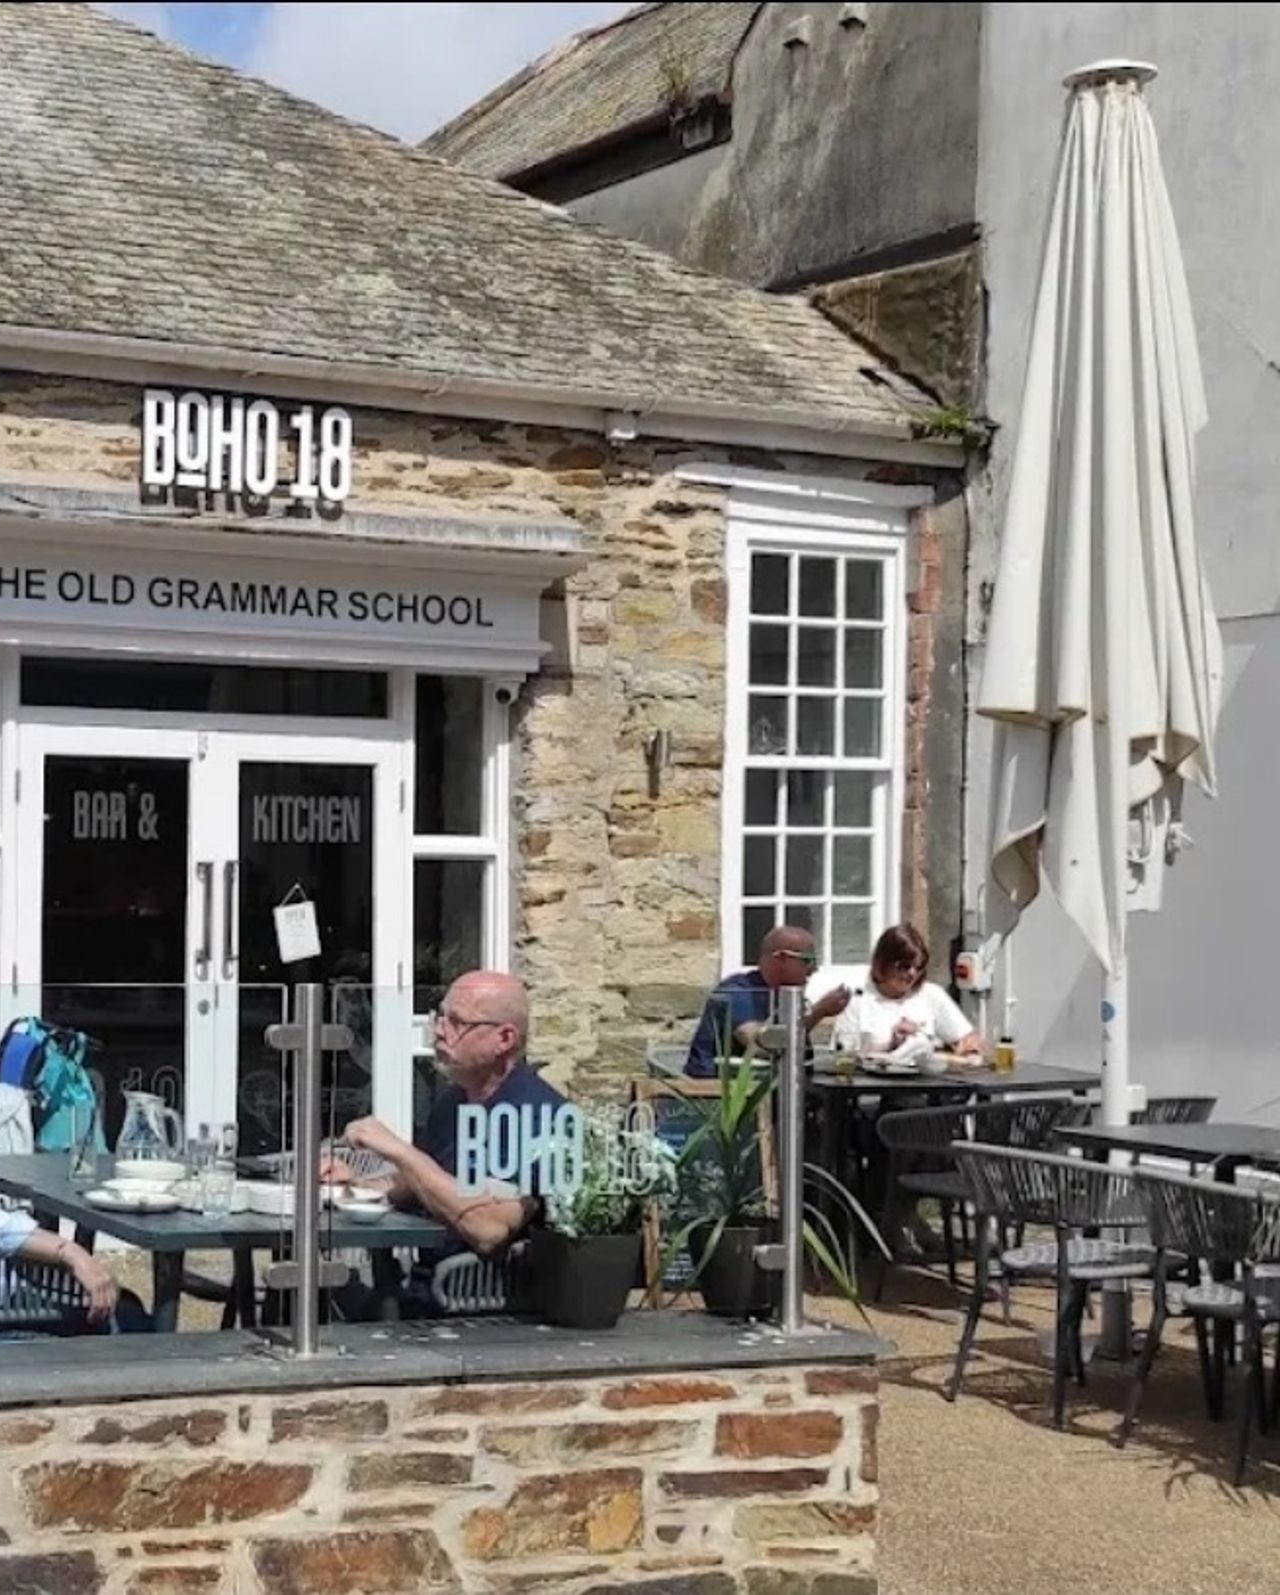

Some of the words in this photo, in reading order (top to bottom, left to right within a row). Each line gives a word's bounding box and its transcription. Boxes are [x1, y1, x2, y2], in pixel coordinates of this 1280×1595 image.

[143, 389, 280, 495] BOHO
[290, 404, 353, 500] 18
[57, 571, 135, 607] OLD
[148, 577, 339, 620] GRAMMAR
[347, 591, 494, 628] SCHOOL
[73, 790, 127, 840] BAR
[138, 792, 160, 841] &
[253, 794, 361, 844] KITCHEN
[456, 1102, 584, 1198] BOHO
